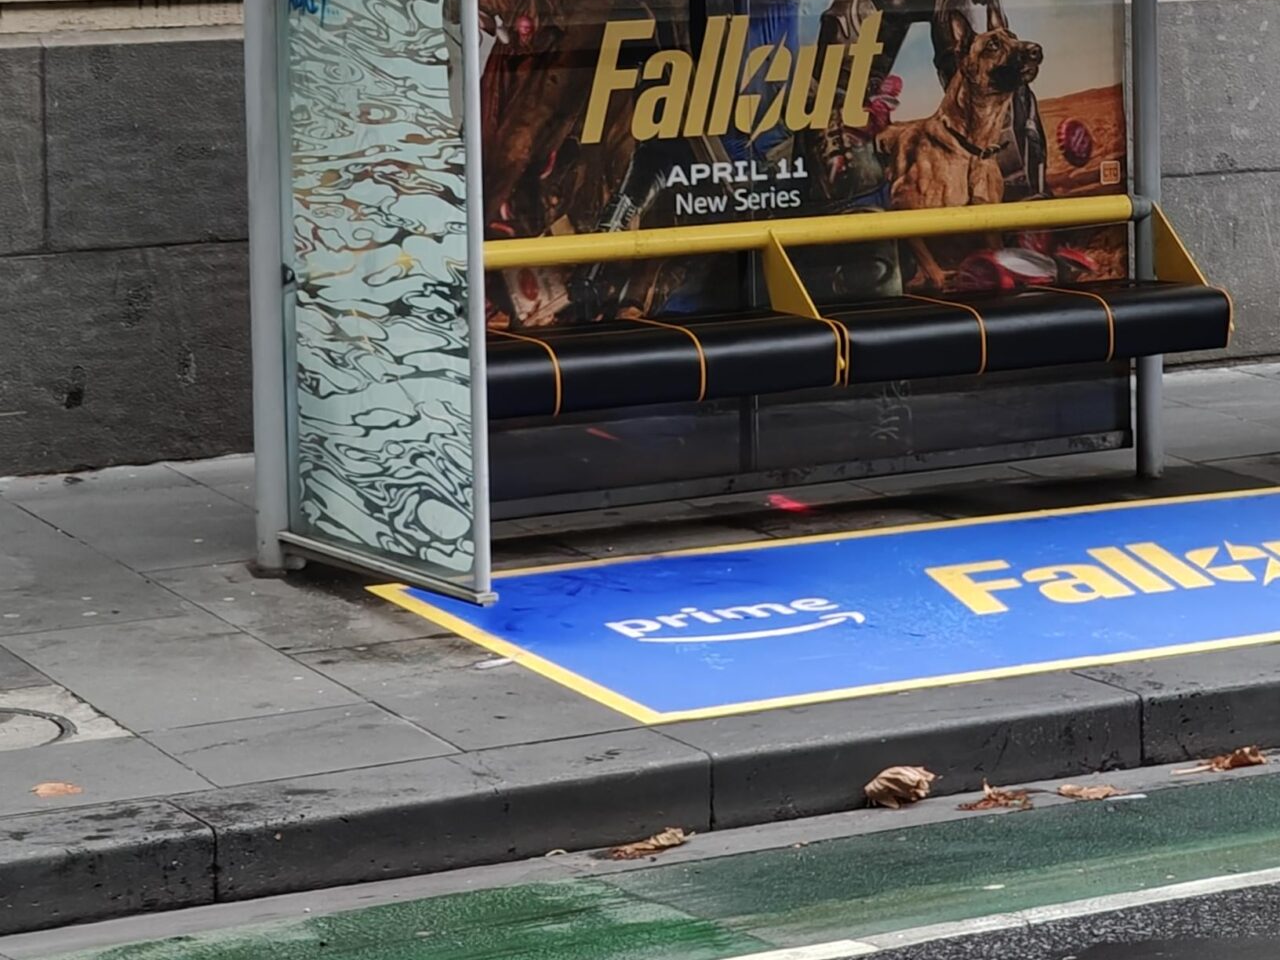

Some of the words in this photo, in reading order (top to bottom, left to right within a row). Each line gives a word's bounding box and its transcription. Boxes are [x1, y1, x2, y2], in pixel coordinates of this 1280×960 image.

[581, 10, 885, 147] Fallout
[666, 160, 768, 187] APRIL
[777, 156, 809, 180] 11
[675, 191, 728, 215] New
[733, 187, 802, 212] Series
[605, 596, 840, 640] prime
